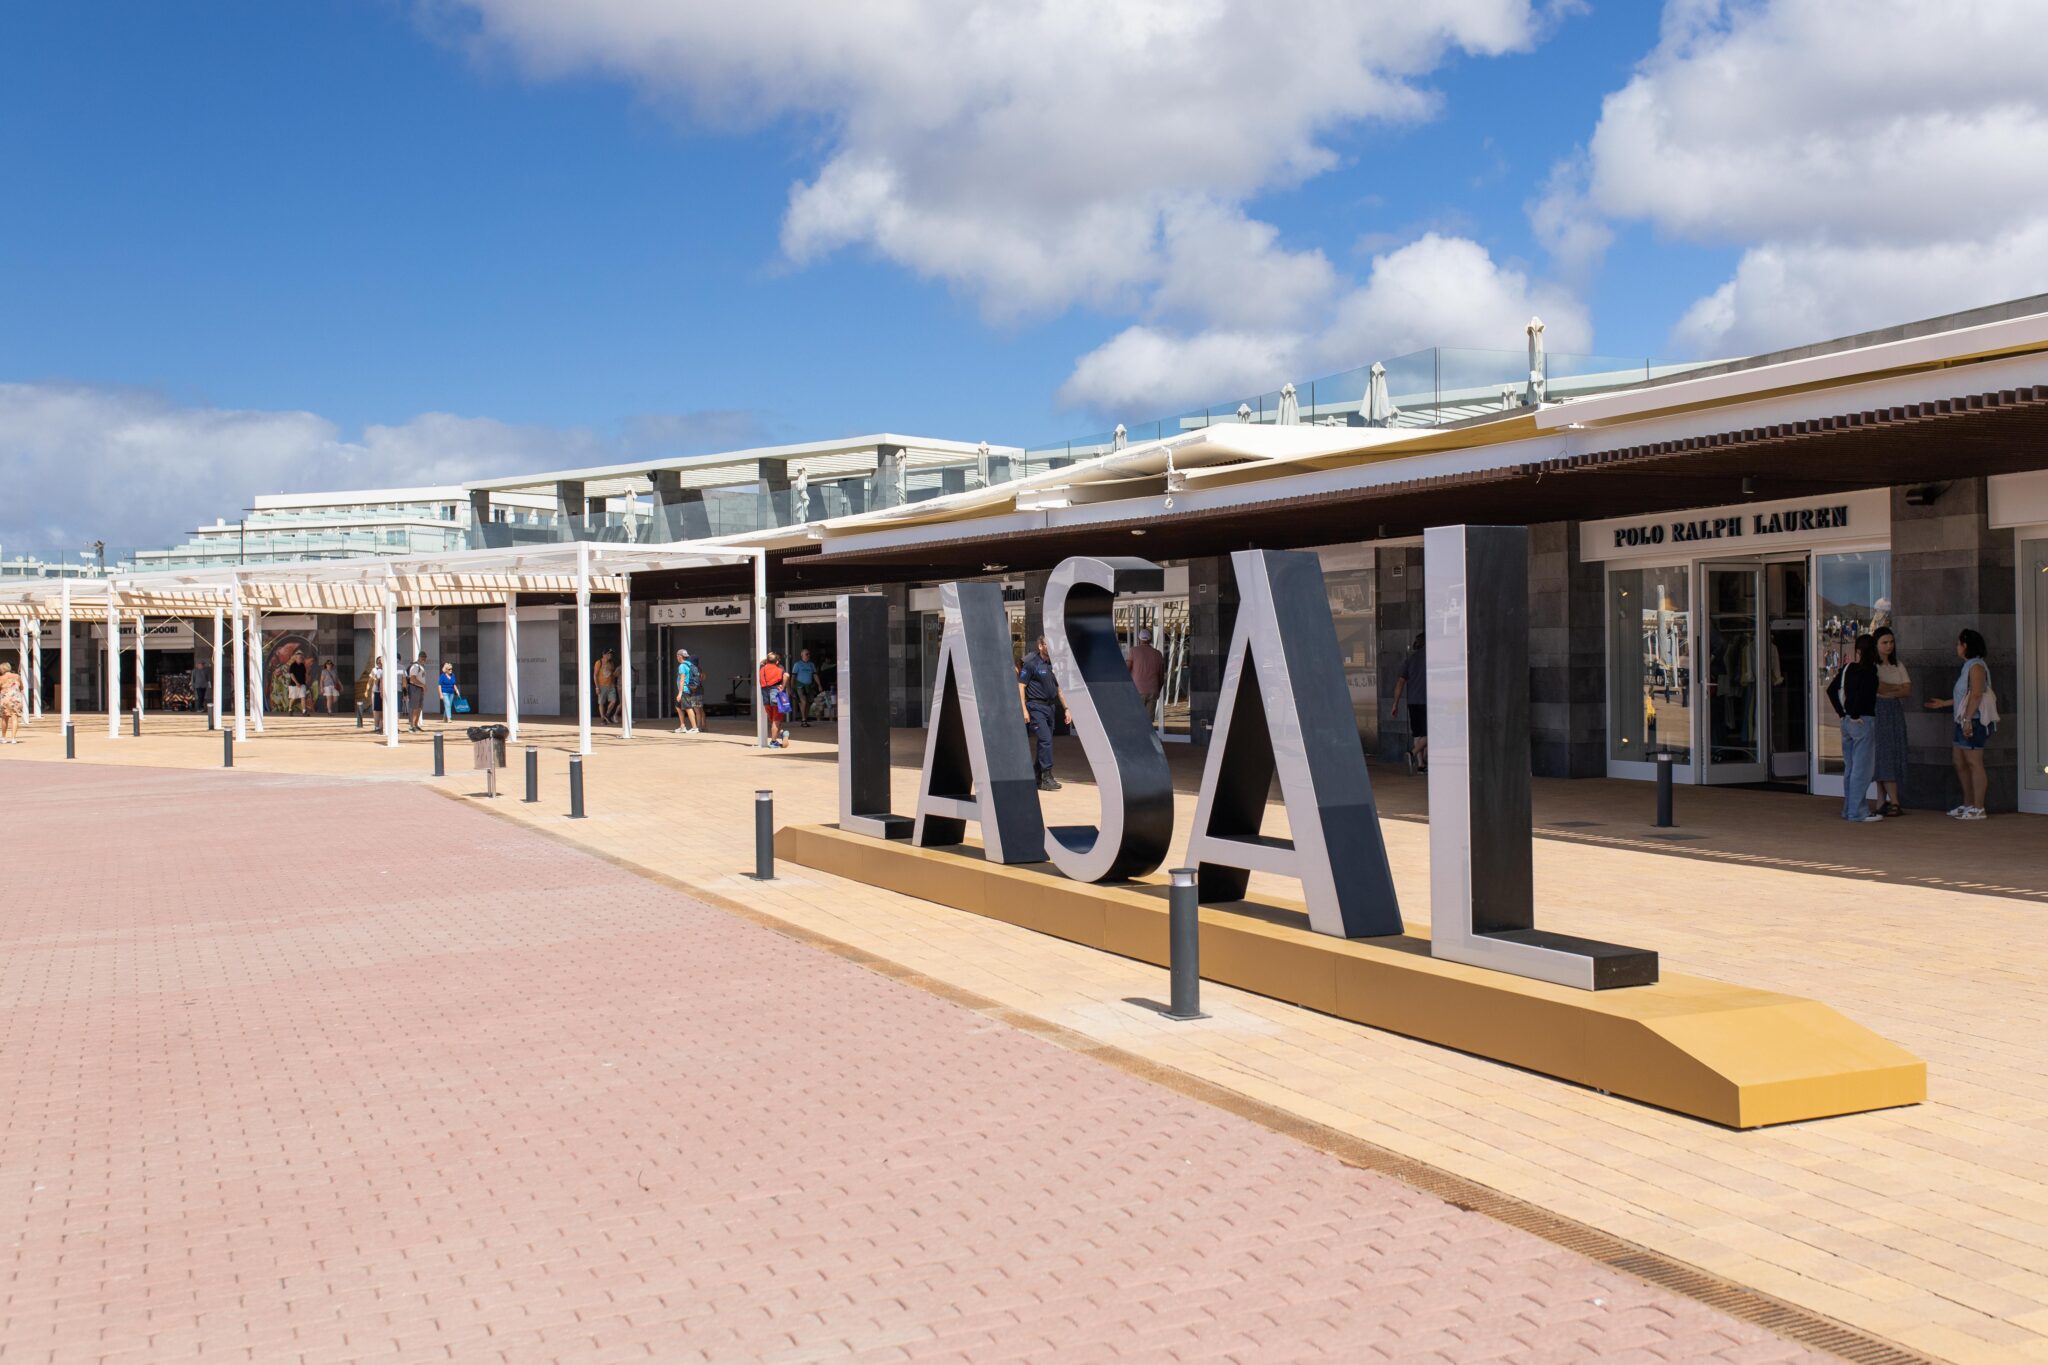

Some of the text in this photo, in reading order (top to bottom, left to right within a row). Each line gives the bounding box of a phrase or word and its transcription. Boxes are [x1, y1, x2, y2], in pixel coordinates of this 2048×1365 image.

[1614, 506, 1848, 547] POLO RALPH LAUREN
[144, 626, 178, 635] ANDOORI
